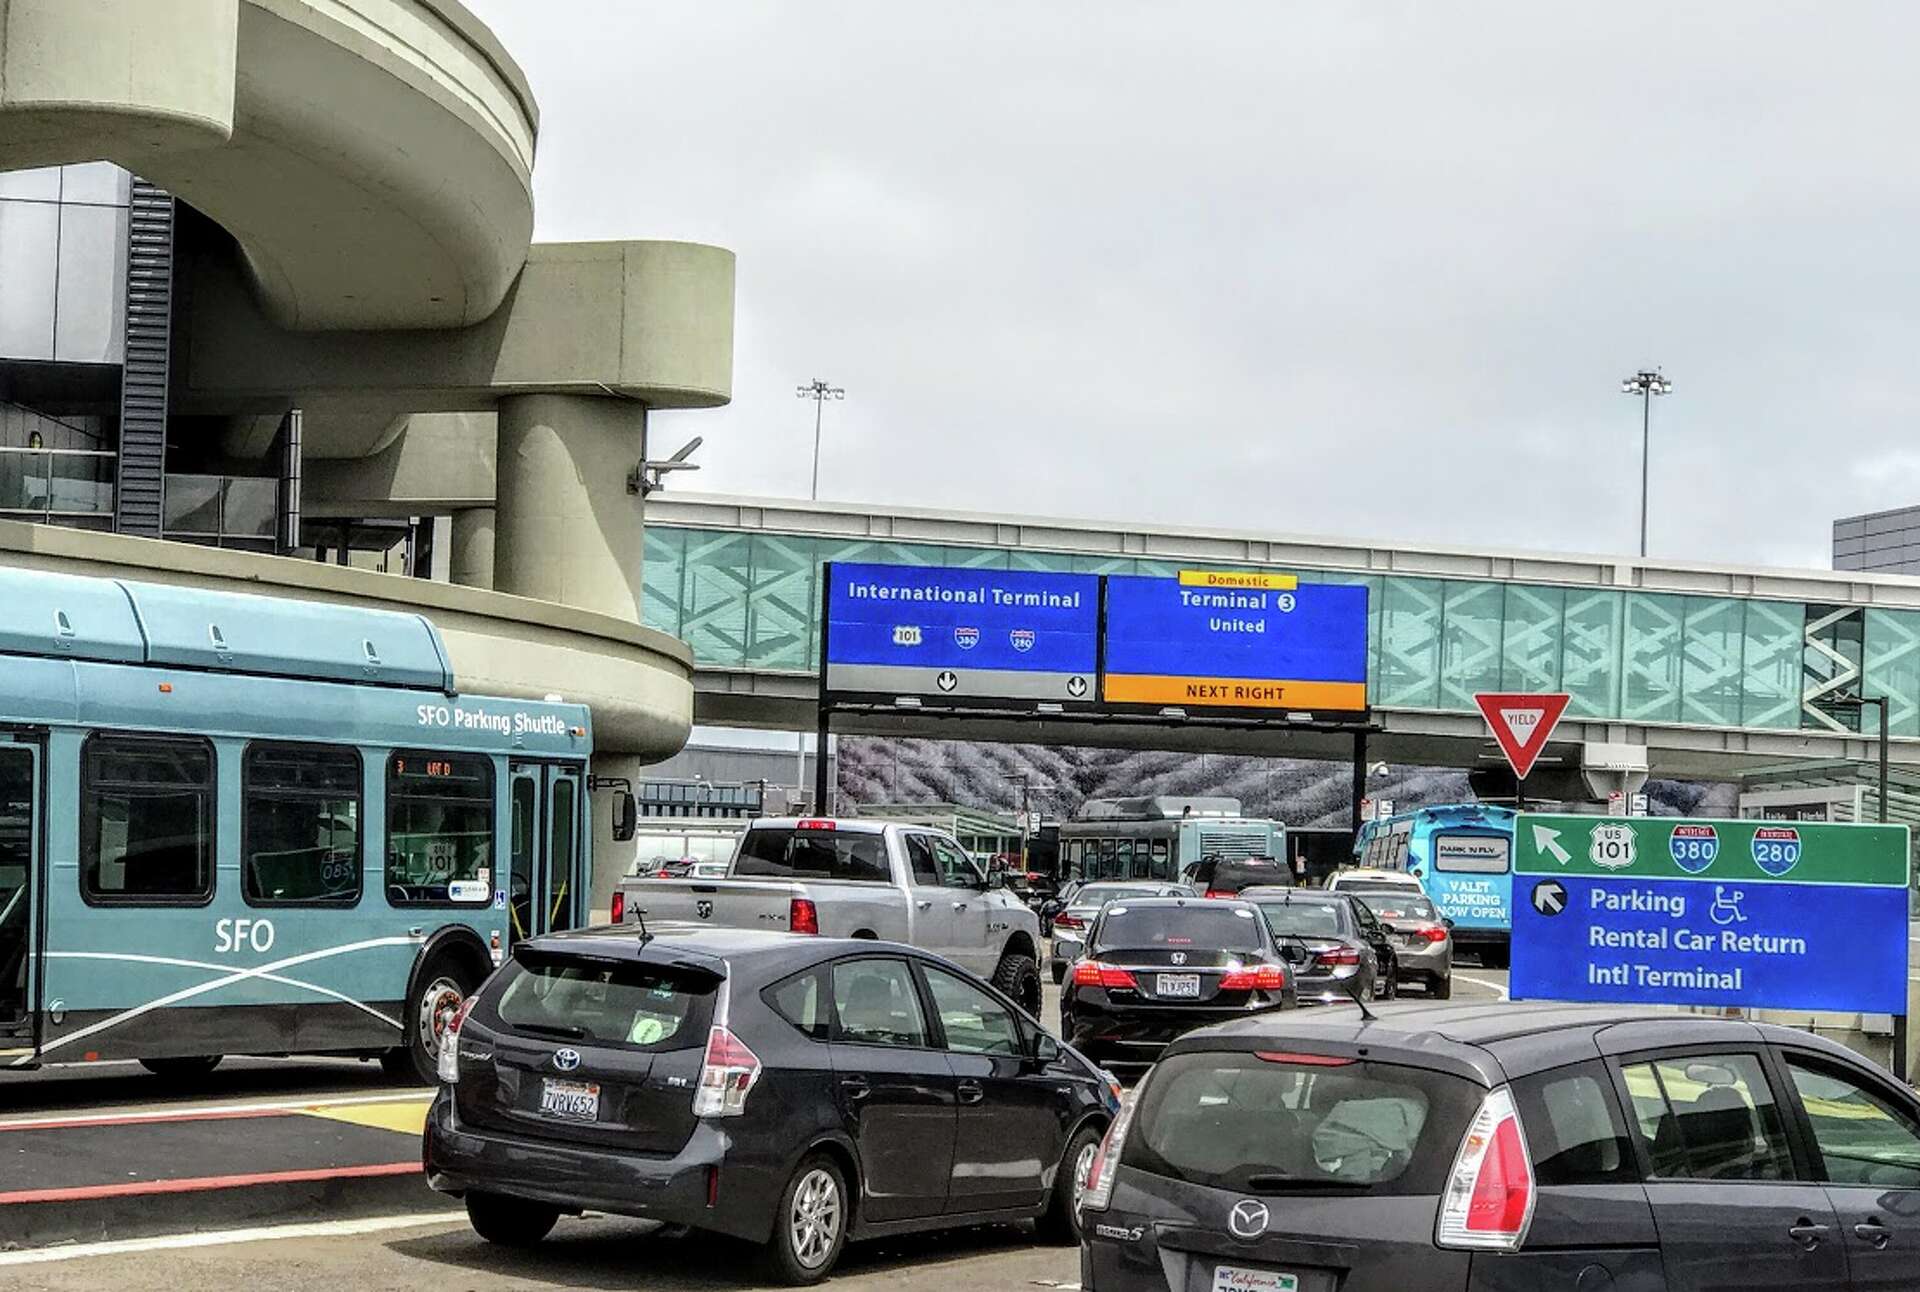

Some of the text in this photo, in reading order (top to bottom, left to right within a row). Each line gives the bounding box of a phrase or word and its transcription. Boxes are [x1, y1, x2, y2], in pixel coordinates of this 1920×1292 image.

[1207, 574, 1269, 587] Domestic
[848, 582, 1081, 608] International Terminal
[1180, 591, 1293, 611] Terminal 3
[1209, 617, 1266, 633] United
[898, 630, 918, 642] 101
[958, 636, 976, 646] 380
[1186, 685, 1285, 700] NEXT RIGHT
[416, 704, 566, 735] SFO Parking Shuttle
[1507, 714, 1537, 725] YIELD
[1604, 830, 1622, 840] US
[1596, 841, 1798, 864] 101 380 280
[1449, 881, 1490, 893] VALET
[1442, 893, 1501, 905] PARKING
[1590, 888, 1686, 917] Parking
[1437, 905, 1507, 919] NOW OPEN
[214, 918, 275, 953] SFO
[1589, 926, 1807, 955] Rental Car Return
[1588, 963, 1743, 990] Intl Terminal
[545, 1092, 594, 1112] 7VRV652
